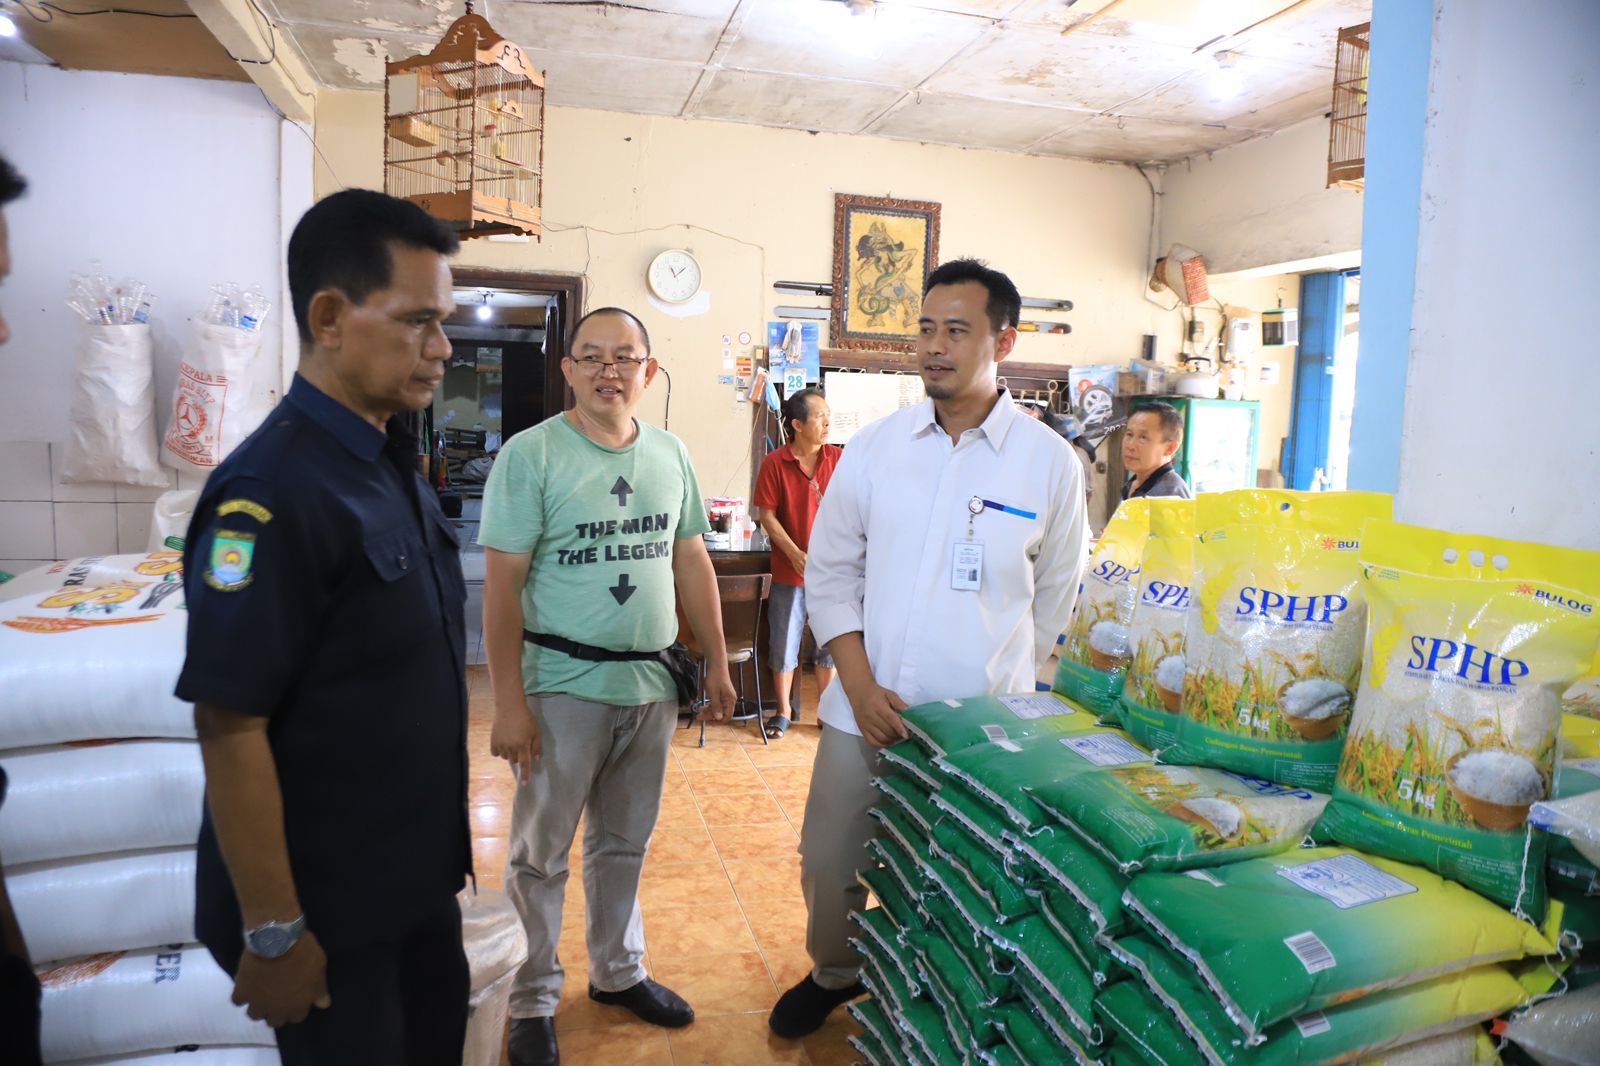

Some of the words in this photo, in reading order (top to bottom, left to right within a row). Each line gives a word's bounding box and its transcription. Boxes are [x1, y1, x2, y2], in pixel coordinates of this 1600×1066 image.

[788, 375, 803, 389] 28
[575, 520, 617, 539] THE
[621, 513, 668, 535] MAN
[557, 547, 598, 565] THE
[1236, 586, 1348, 624] SPHP
[1535, 589, 1593, 613] BULOG
[1407, 635, 1529, 686] SPHP
